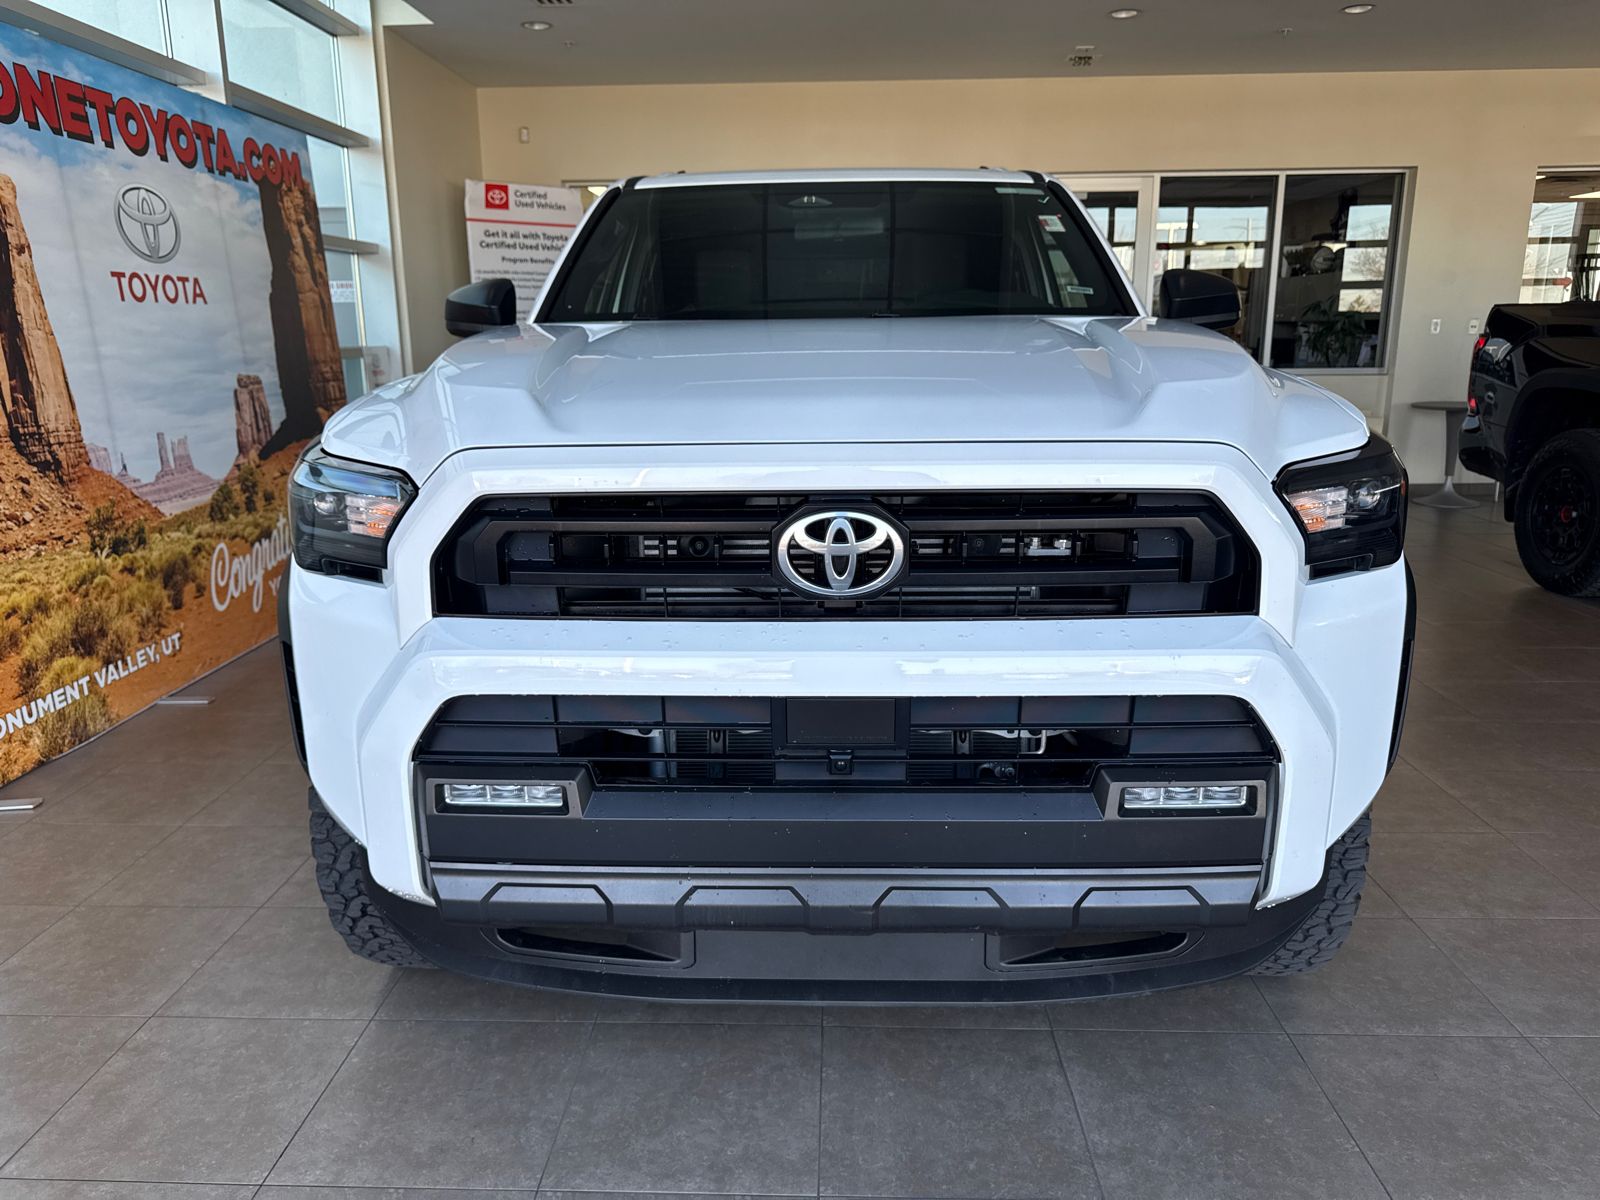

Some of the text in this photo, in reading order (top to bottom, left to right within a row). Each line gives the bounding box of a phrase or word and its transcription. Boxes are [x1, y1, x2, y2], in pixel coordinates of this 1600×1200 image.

[514, 189, 548, 200] Certified
[515, 200, 567, 211] Used Vehicles
[484, 229, 569, 243] Get it all with Toyota
[480, 240, 518, 250] Certified
[519, 242, 540, 251] Used
[502, 255, 529, 265] Program
[110, 270, 208, 305] TOYOTA
[93, 643, 160, 689] VALLEY,
[161, 632, 182, 656] UT
